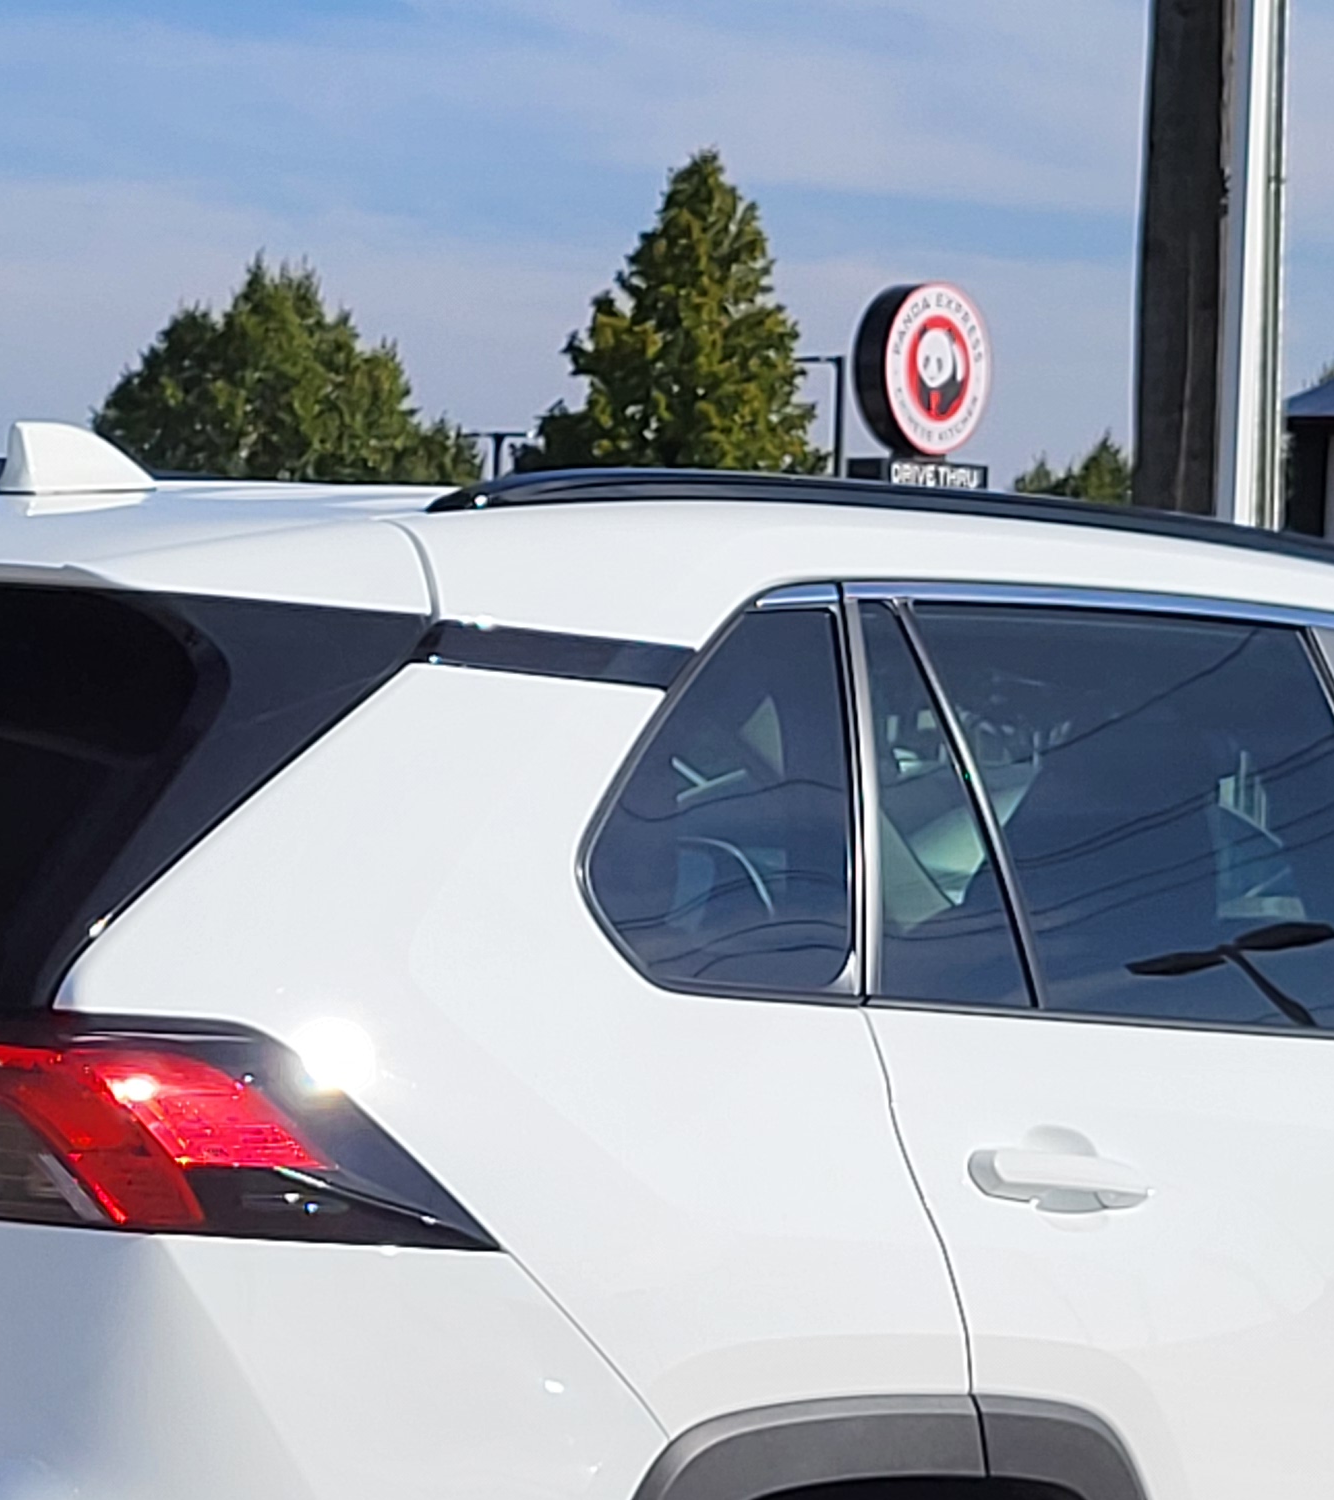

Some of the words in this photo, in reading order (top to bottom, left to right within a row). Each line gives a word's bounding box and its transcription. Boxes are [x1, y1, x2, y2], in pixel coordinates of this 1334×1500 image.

[894, 297, 931, 356] PANDA
[935, 292, 983, 363] EXPRESS
[891, 461, 935, 488] DRIVE
[937, 465, 979, 489] THRU
